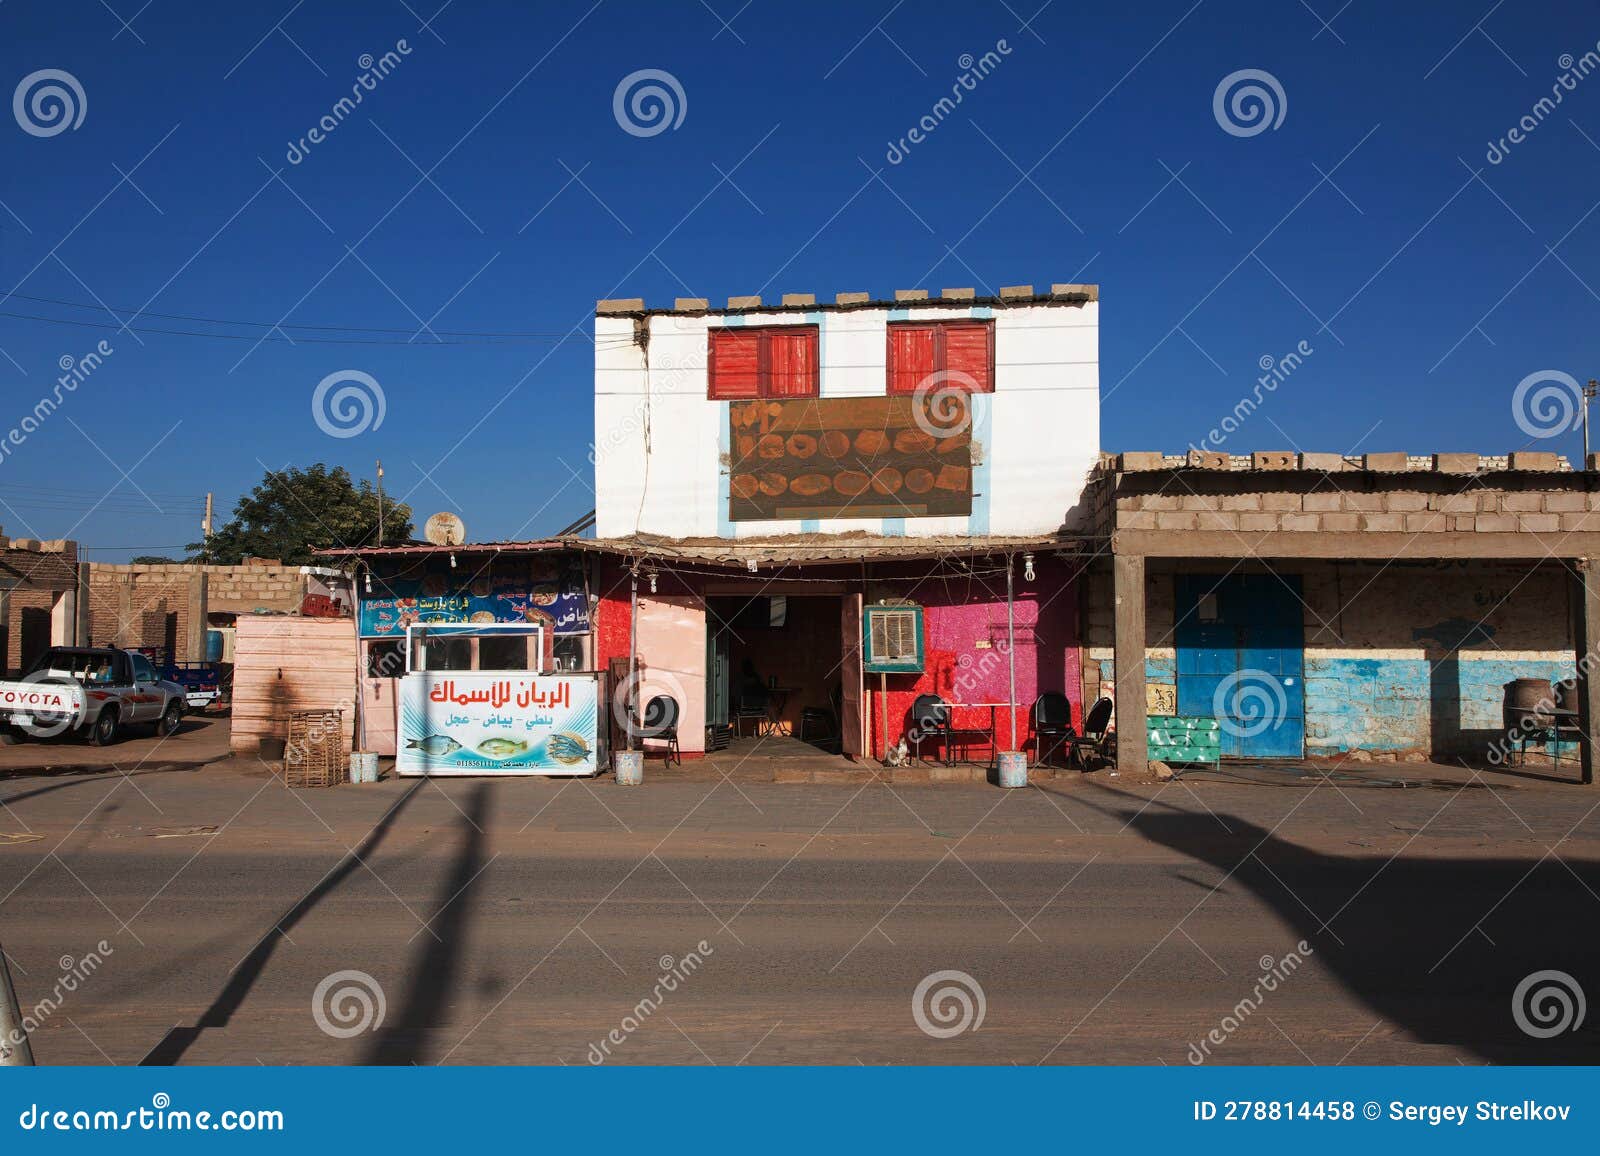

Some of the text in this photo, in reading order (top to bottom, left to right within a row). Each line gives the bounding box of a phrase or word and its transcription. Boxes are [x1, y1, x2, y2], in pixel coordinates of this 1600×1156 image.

[0, 691, 61, 706] OYOTA
[430, 680, 570, 709] الريان للأسماك
[445, 713, 470, 728] عجل
[482, 713, 513, 728] بياض
[525, 714, 553, 730] بلطي
